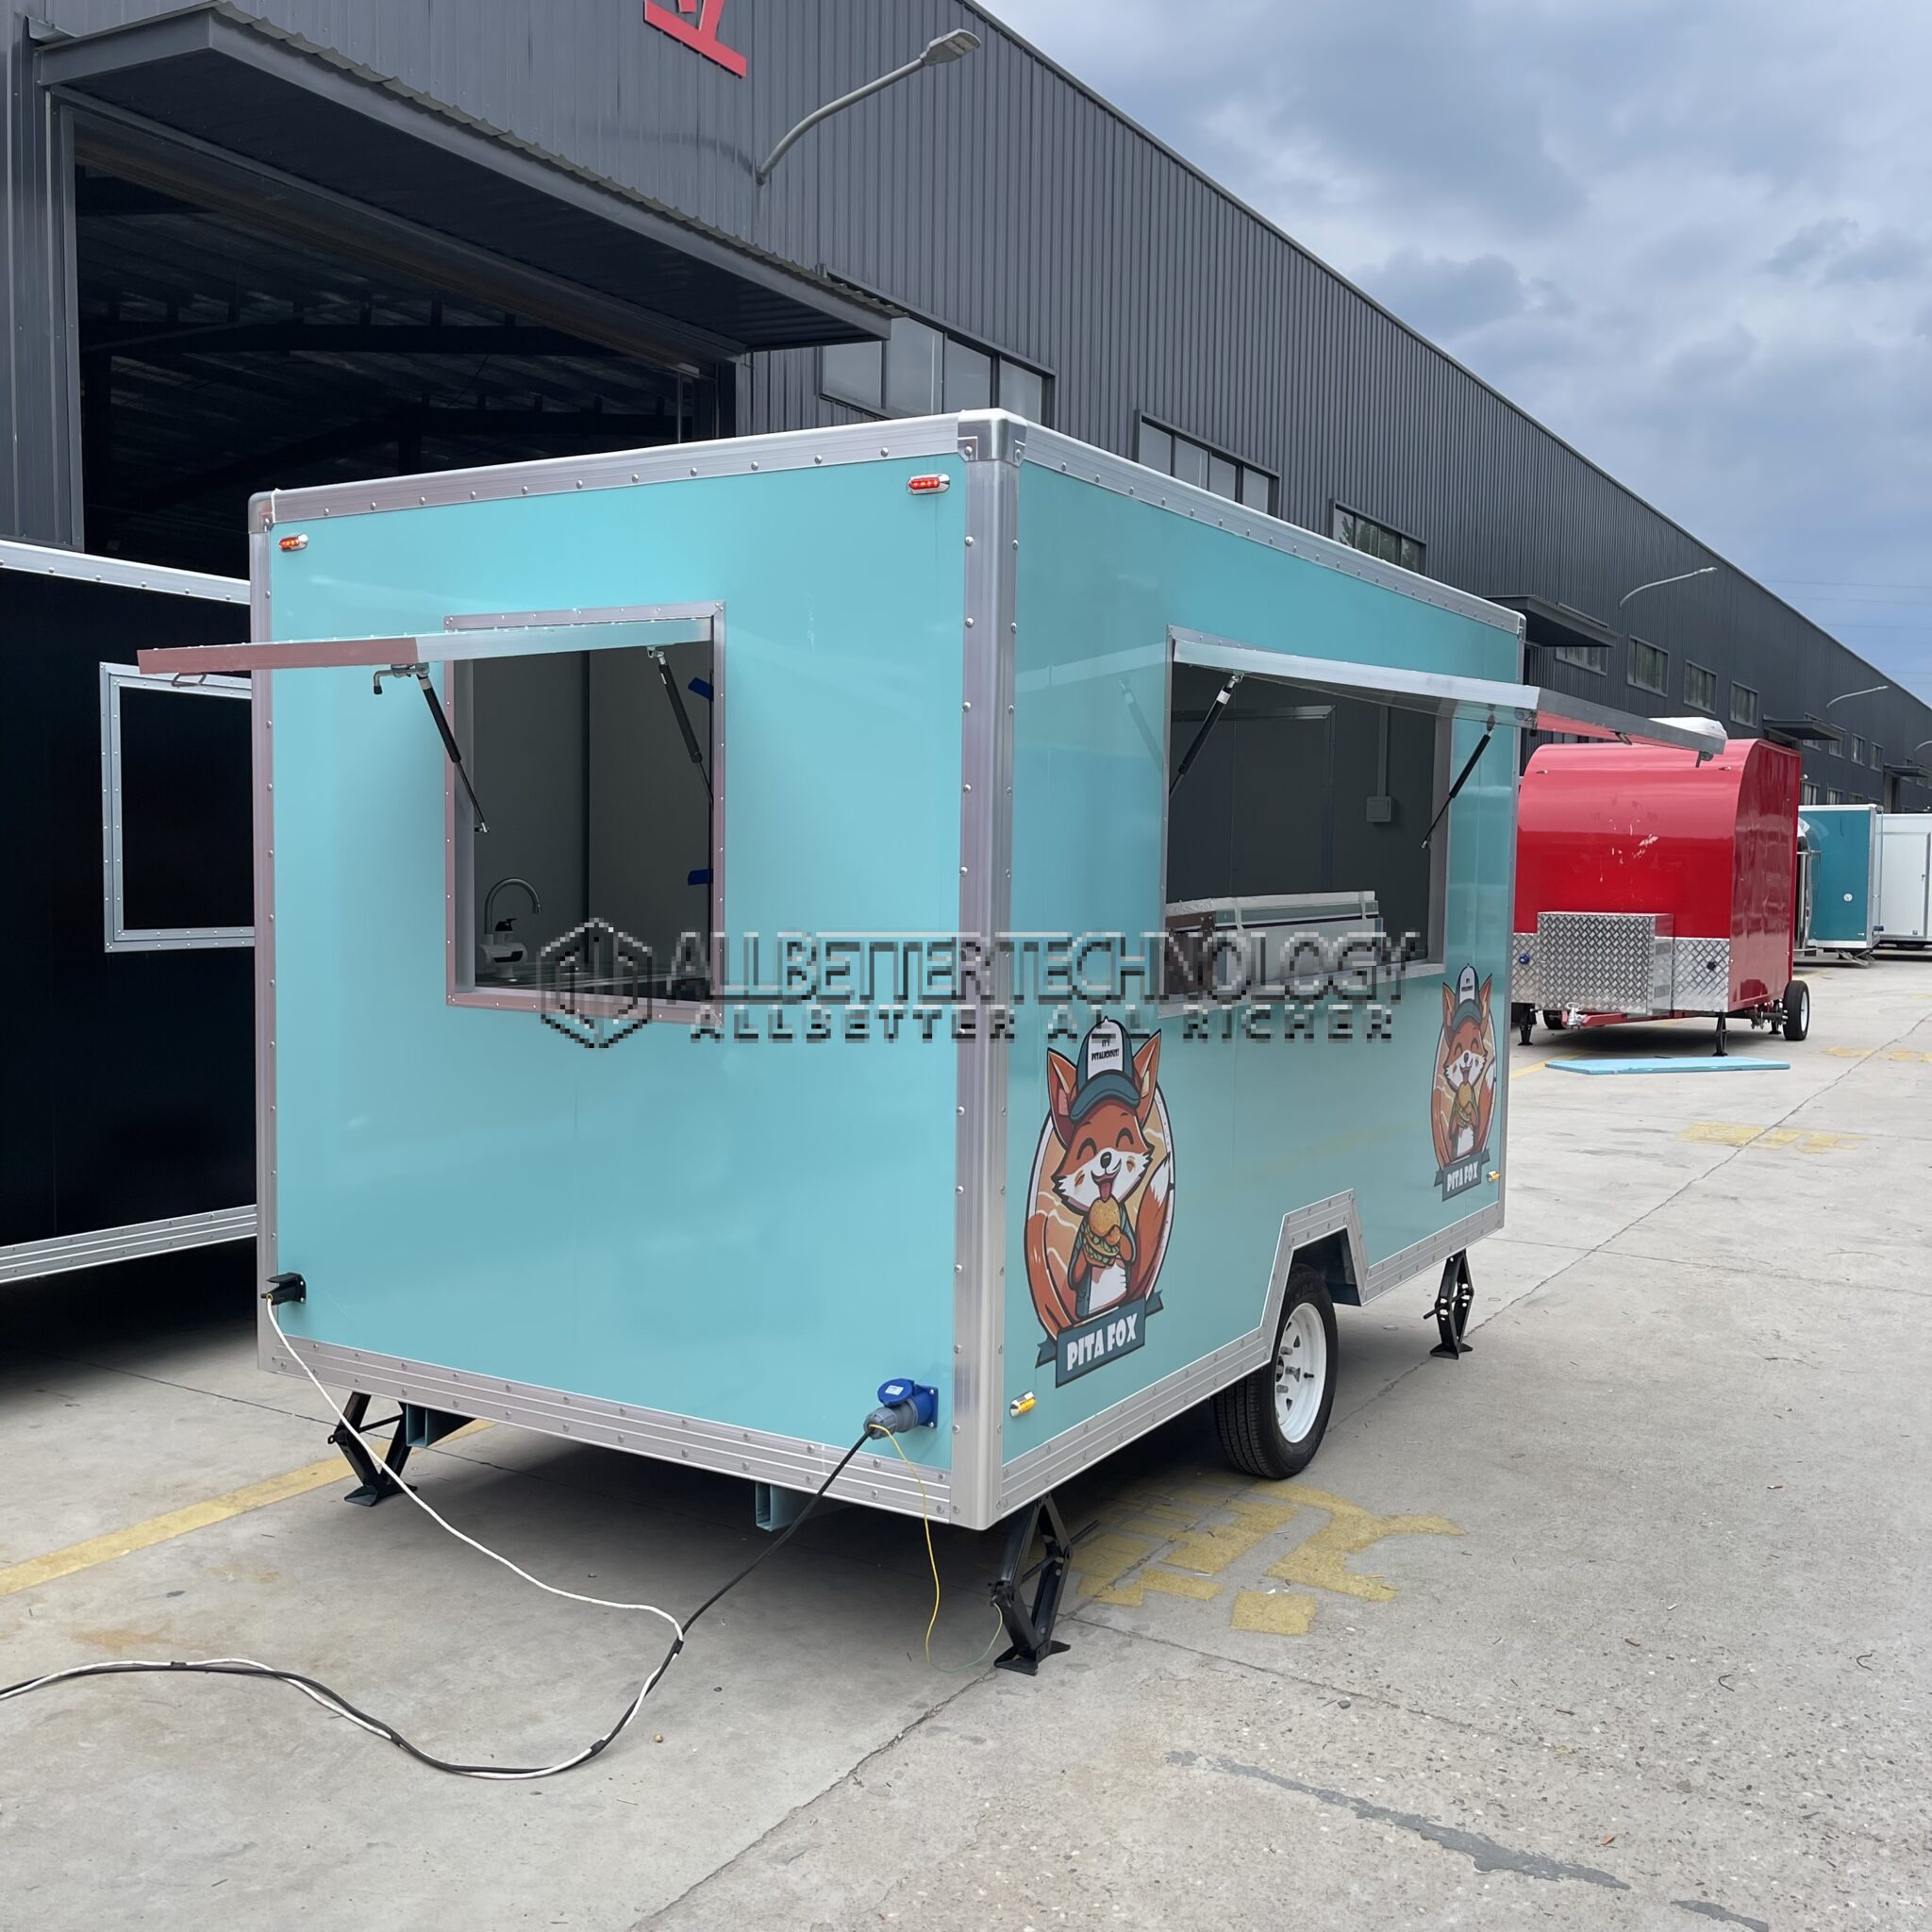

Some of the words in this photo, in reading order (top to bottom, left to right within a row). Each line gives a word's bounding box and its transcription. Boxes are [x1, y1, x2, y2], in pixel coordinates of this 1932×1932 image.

[1446, 1168, 1463, 1192] PITA
[1464, 1161, 1478, 1184] FOX
[1067, 1328, 1105, 1372] PITA
[1107, 1313, 1138, 1347] FOX
